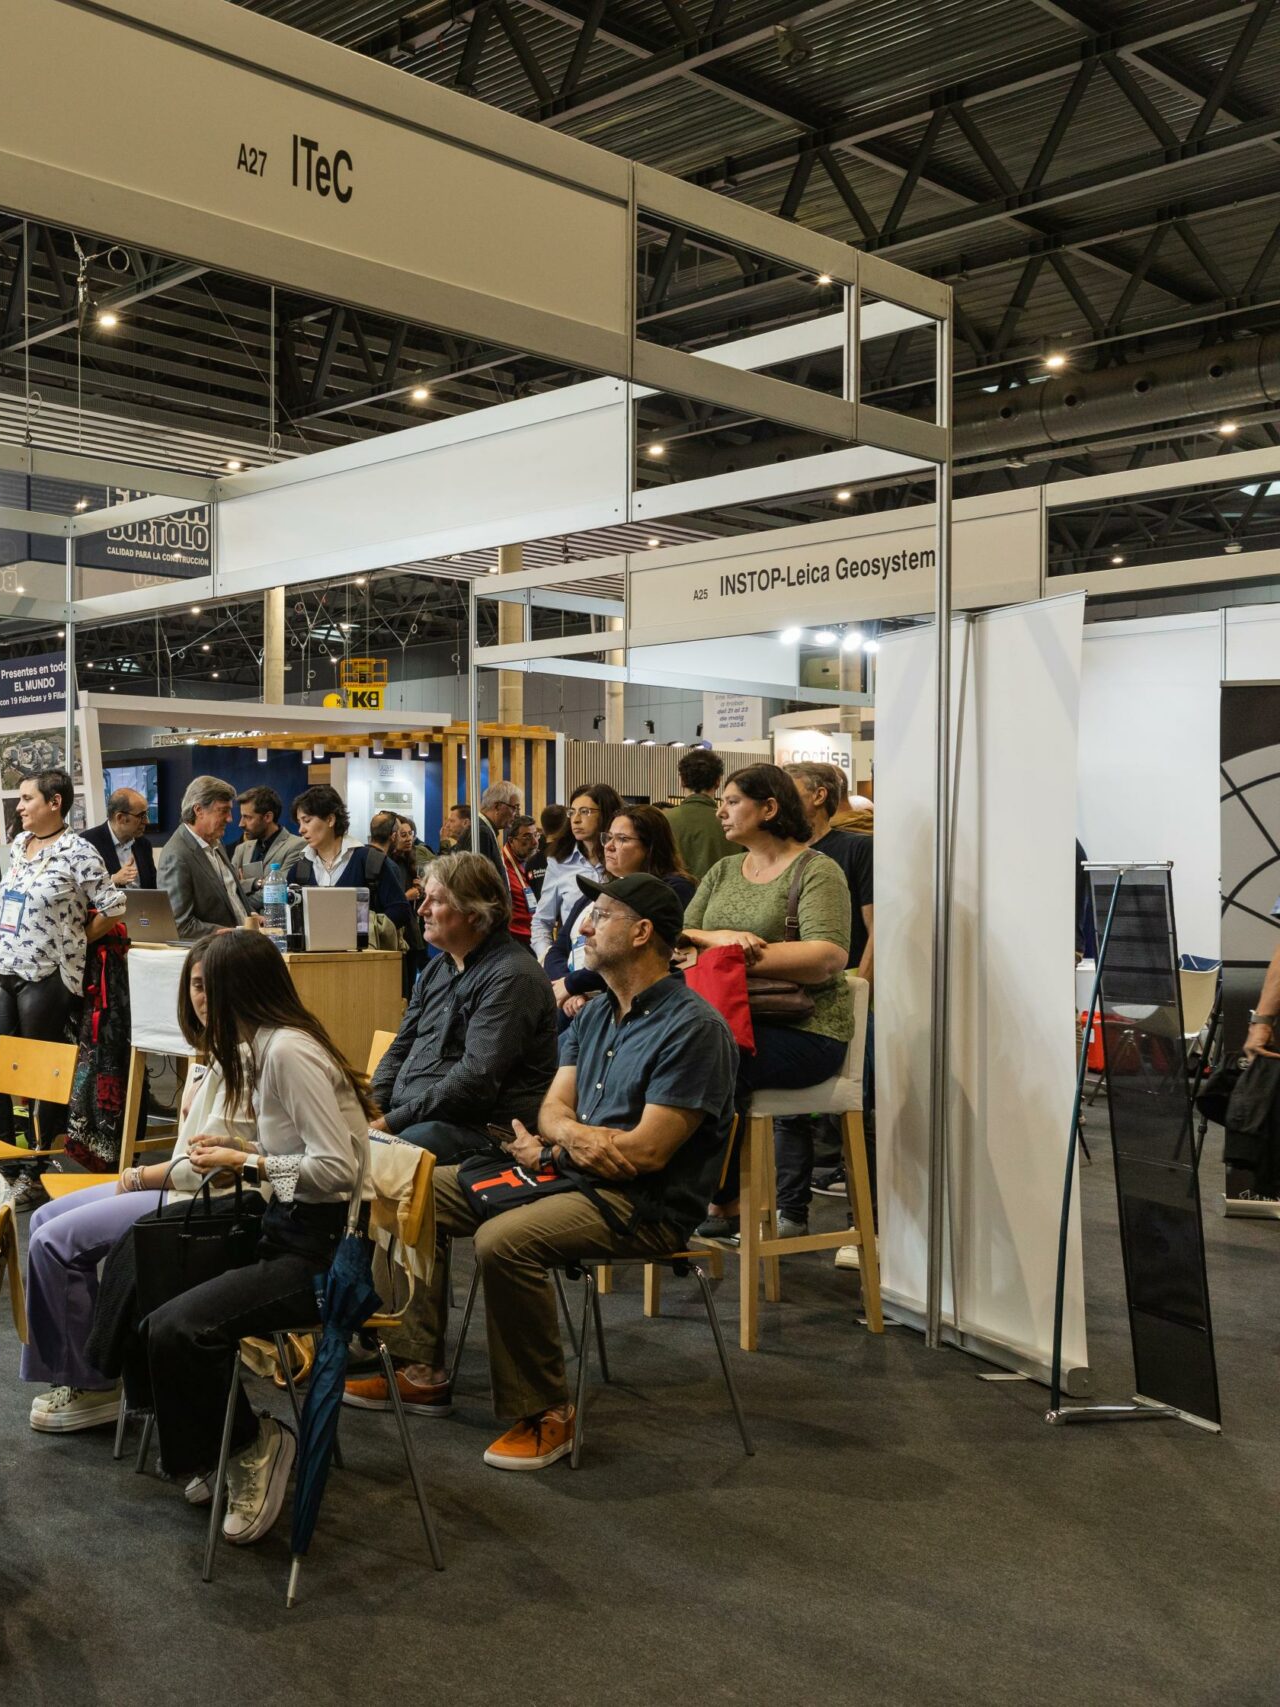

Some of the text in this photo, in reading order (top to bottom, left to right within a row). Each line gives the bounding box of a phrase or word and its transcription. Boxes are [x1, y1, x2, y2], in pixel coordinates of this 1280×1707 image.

[237, 134, 353, 203] A27 ITeC
[106, 546, 209, 566] CALIDAD PARA LA CONSTRUCCIÓN
[693, 549, 936, 601] A25 INSTOP-Leica Geosystem
[0, 666, 38, 680] Presentes
[39, 665, 49, 675] en
[14, 677, 55, 692] EL MUNDO
[0, 698, 10, 706] con
[10, 696, 18, 705] 19
[47, 692, 52, 700] 9
